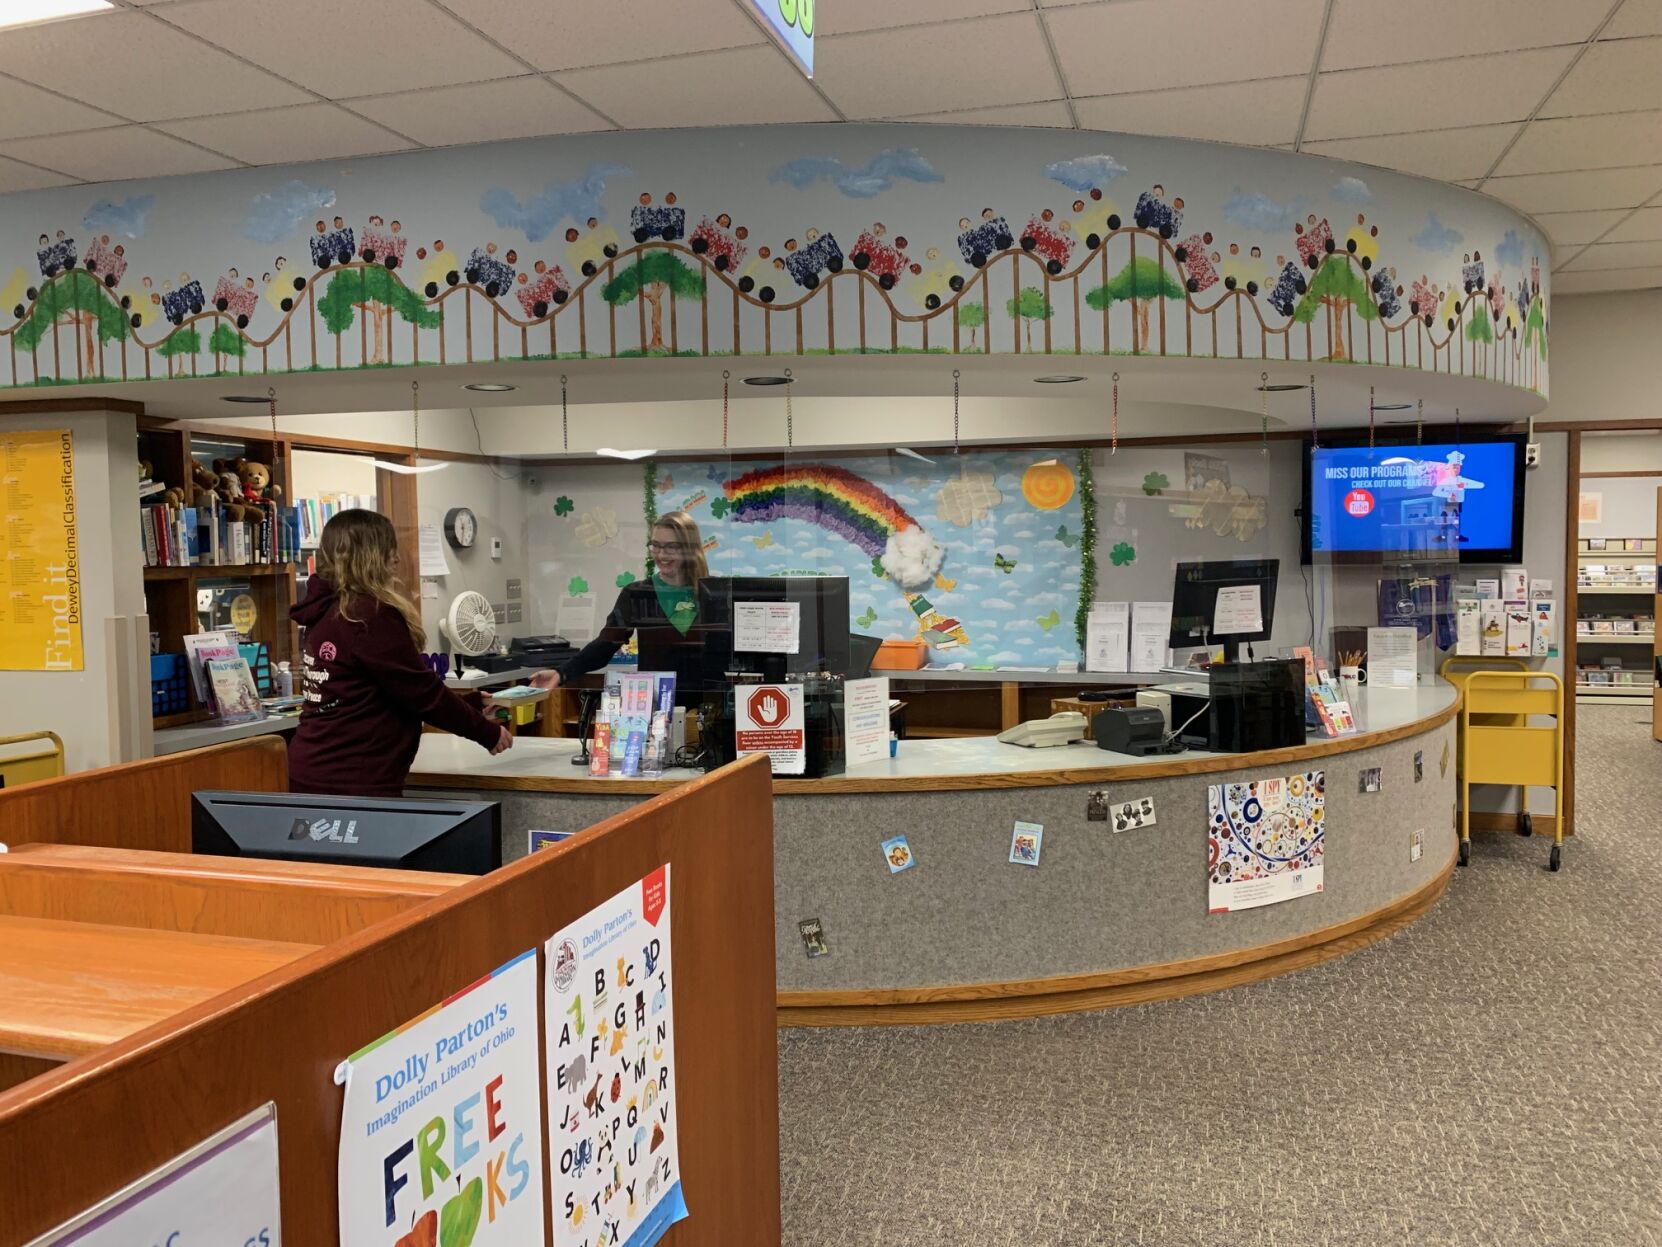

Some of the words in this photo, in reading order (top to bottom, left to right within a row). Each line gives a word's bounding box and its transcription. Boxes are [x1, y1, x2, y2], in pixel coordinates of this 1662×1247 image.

[1326, 467, 1348, 478] MISS
[1350, 466, 1369, 478] OUR
[1352, 492, 1366, 500] You
[1352, 504, 1368, 512] Tube
[1388, 480, 1402, 488] OUR
[61, 433, 79, 624] DeweyDecimalClassification
[43, 562, 68, 586] it
[42, 594, 72, 670] Find
[288, 818, 359, 844] DELL
[1268, 780, 1280, 794] SPY
[583, 929, 602, 948] Dolly
[604, 909, 632, 934] Parton's
[559, 1022, 570, 1048] A
[595, 968, 606, 996] B
[626, 964, 634, 986] C
[650, 939, 660, 962] D
[366, 1079, 438, 1136] Imagination
[440, 1052, 478, 1086] Library
[480, 1040, 491, 1058] of
[492, 1027, 516, 1048] Ohio
[376, 1053, 430, 1104] Dolly
[435, 1003, 508, 1064] Parton's
[557, 1064, 566, 1090] E
[590, 1036, 599, 1063] F
[614, 1002, 626, 1029] G
[560, 1105, 570, 1130] J
[596, 1091, 605, 1118] K
[634, 1056, 646, 1083] M
[657, 1021, 666, 1045] N
[384, 1074, 506, 1228] FREE
[560, 1148, 572, 1174] O
[612, 1116, 620, 1140] P
[627, 1106, 638, 1128] Q
[659, 1066, 668, 1091] R
[565, 1191, 574, 1219] S
[592, 1192, 600, 1216] T
[628, 1142, 637, 1166] U
[660, 1102, 668, 1124] V
[610, 1220, 620, 1246] X
[626, 1178, 636, 1205] Y
[662, 1157, 670, 1182] Z
